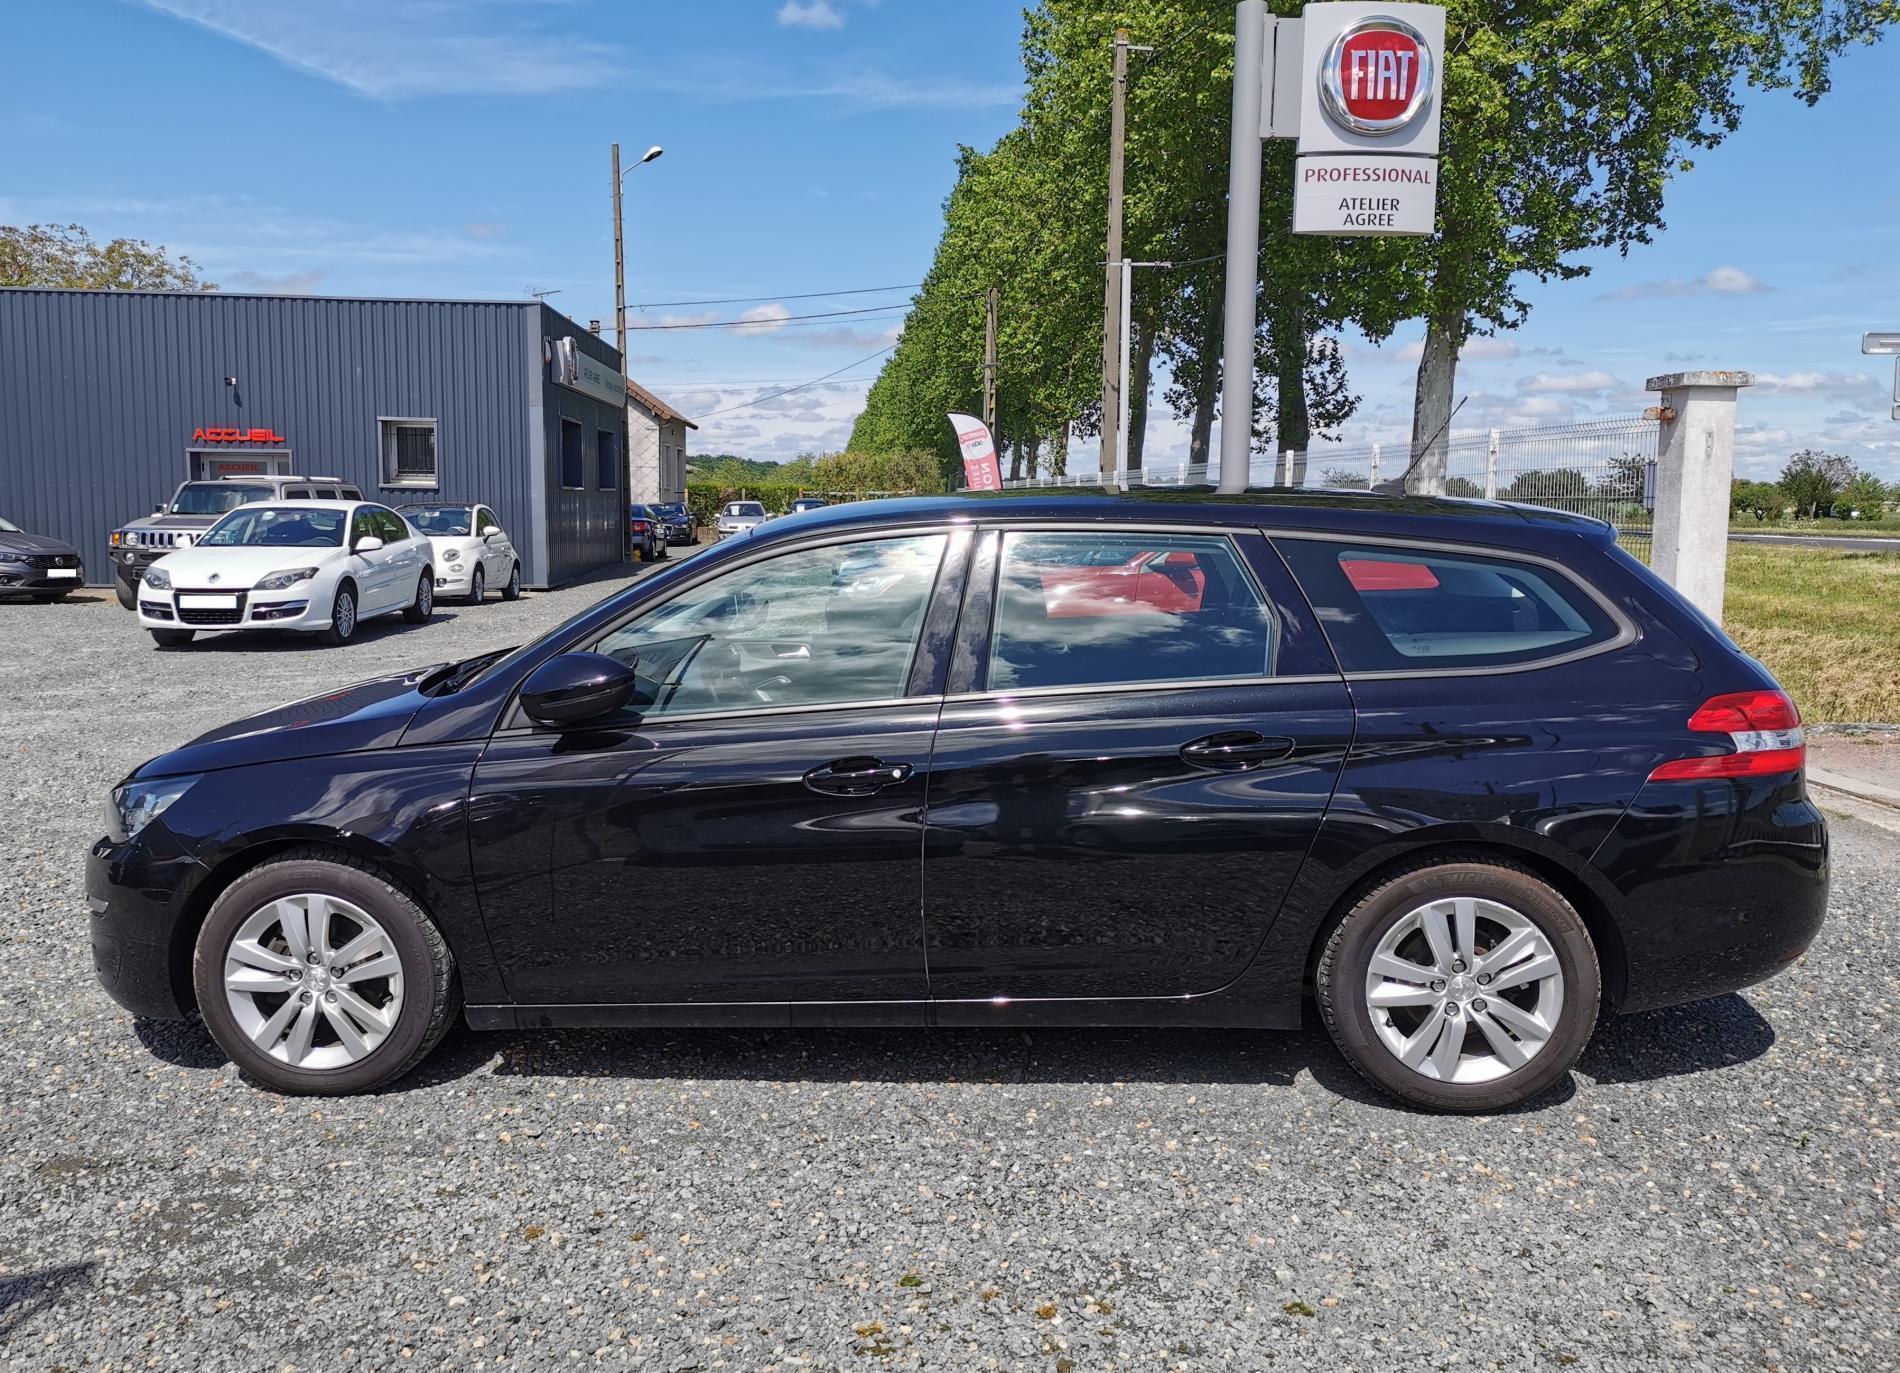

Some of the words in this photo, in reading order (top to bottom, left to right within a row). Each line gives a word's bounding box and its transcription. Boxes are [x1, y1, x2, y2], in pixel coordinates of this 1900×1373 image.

[1351, 49, 1414, 101] FIAT
[1304, 168, 1431, 184] PROFESSIONAL
[1339, 198, 1400, 211] ATELIER
[1343, 213, 1395, 226] AGREE
[192, 427, 285, 441] ACCUEIL
